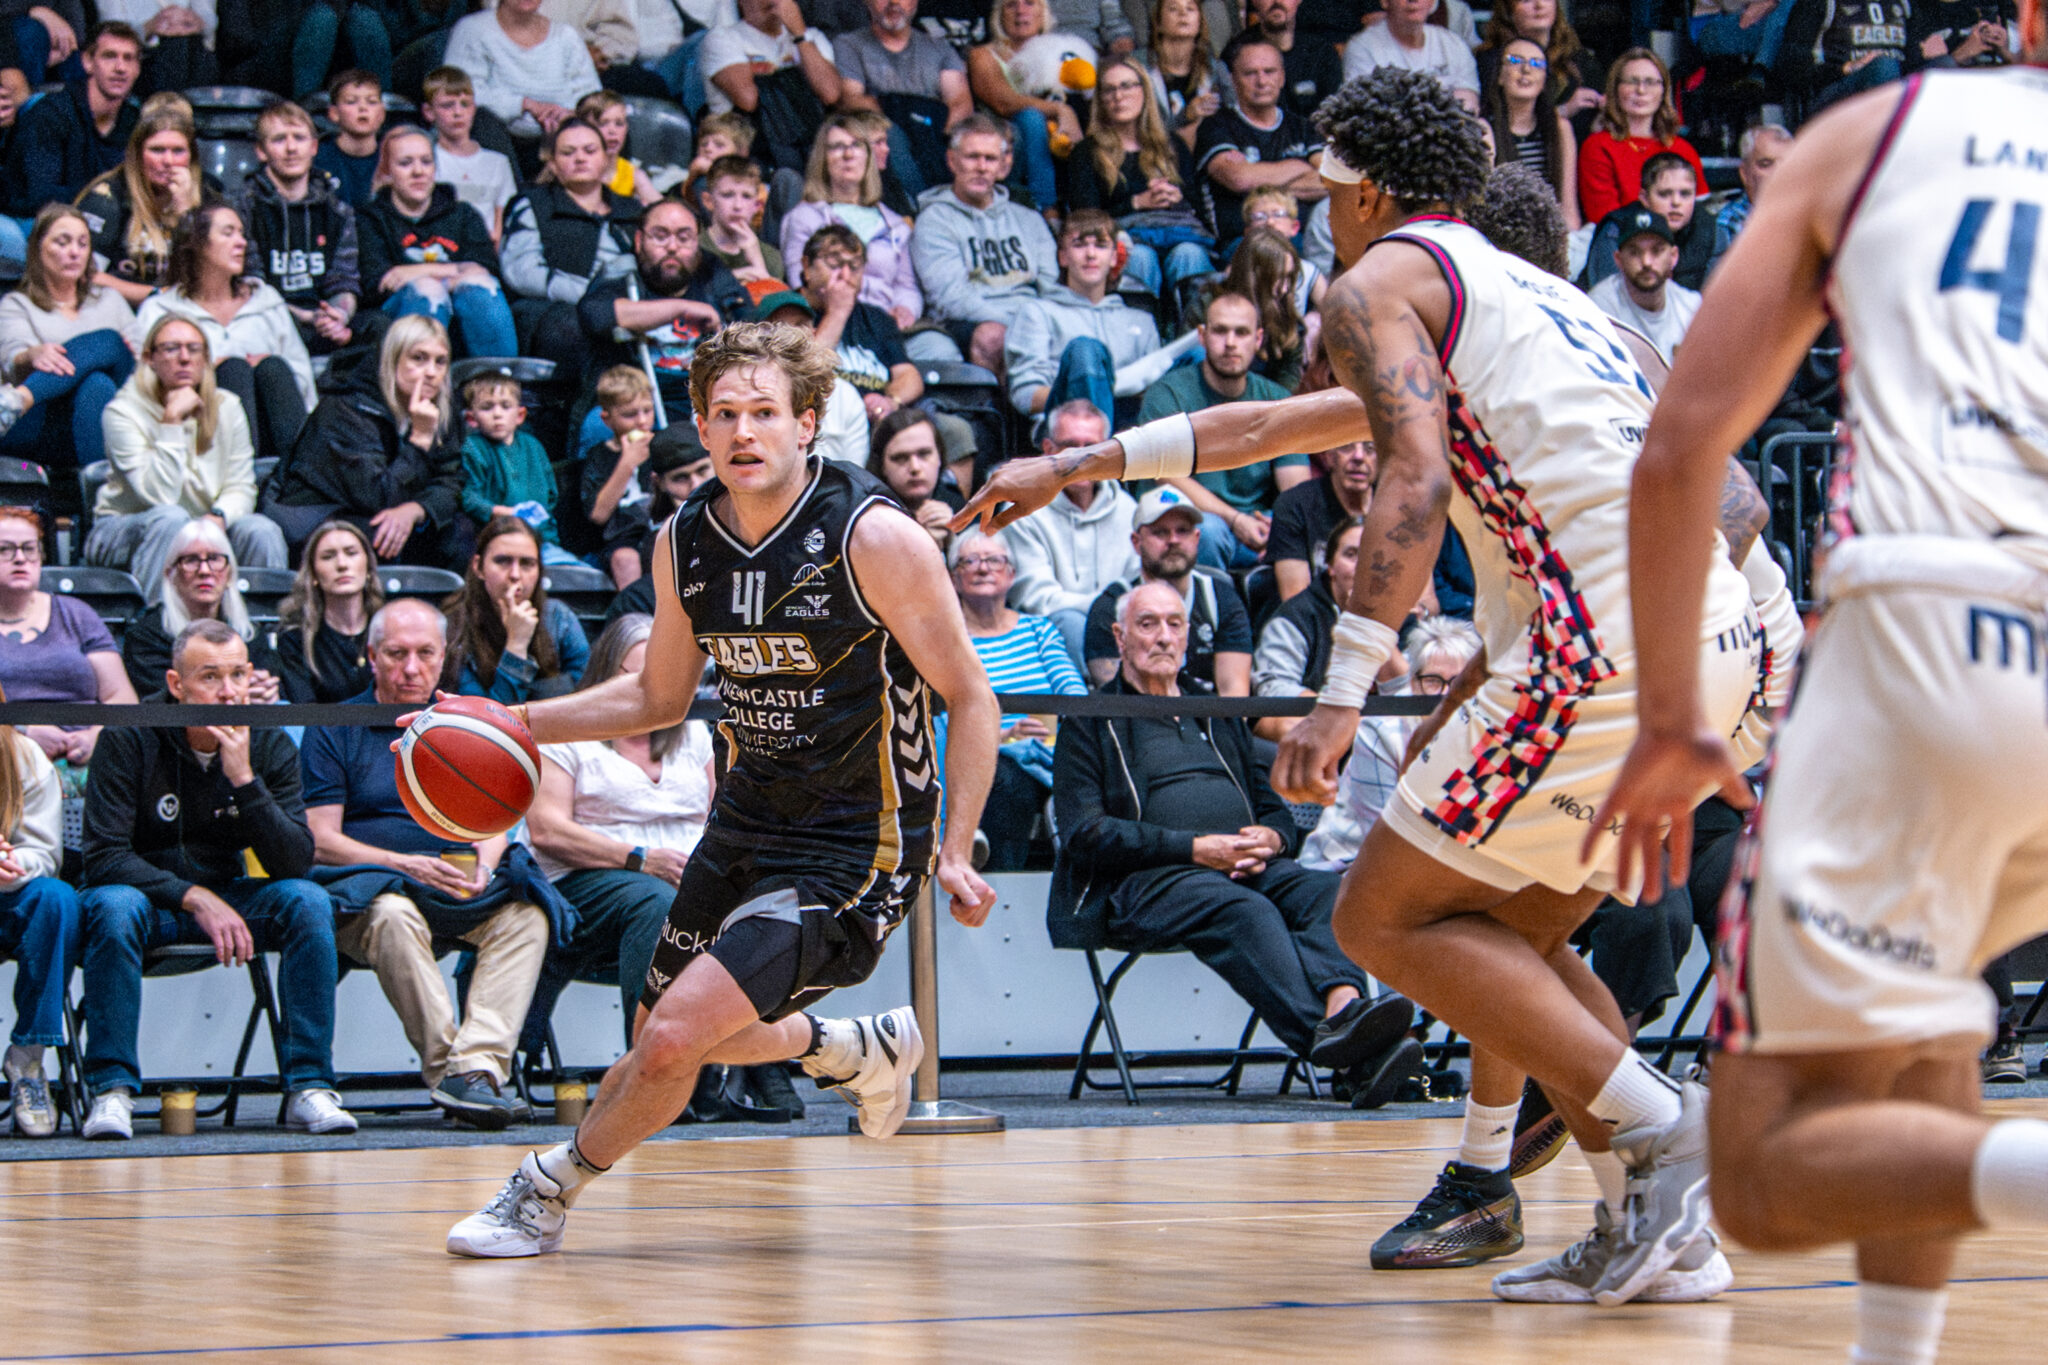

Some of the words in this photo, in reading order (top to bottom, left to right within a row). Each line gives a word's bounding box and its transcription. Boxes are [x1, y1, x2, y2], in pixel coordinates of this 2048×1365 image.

[1937, 198, 2042, 346] 4
[732, 571, 767, 626] 41
[784, 607, 830, 617] EAGLES
[723, 678, 825, 708] NEWCASTLE
[728, 705, 796, 731] OLLEGE
